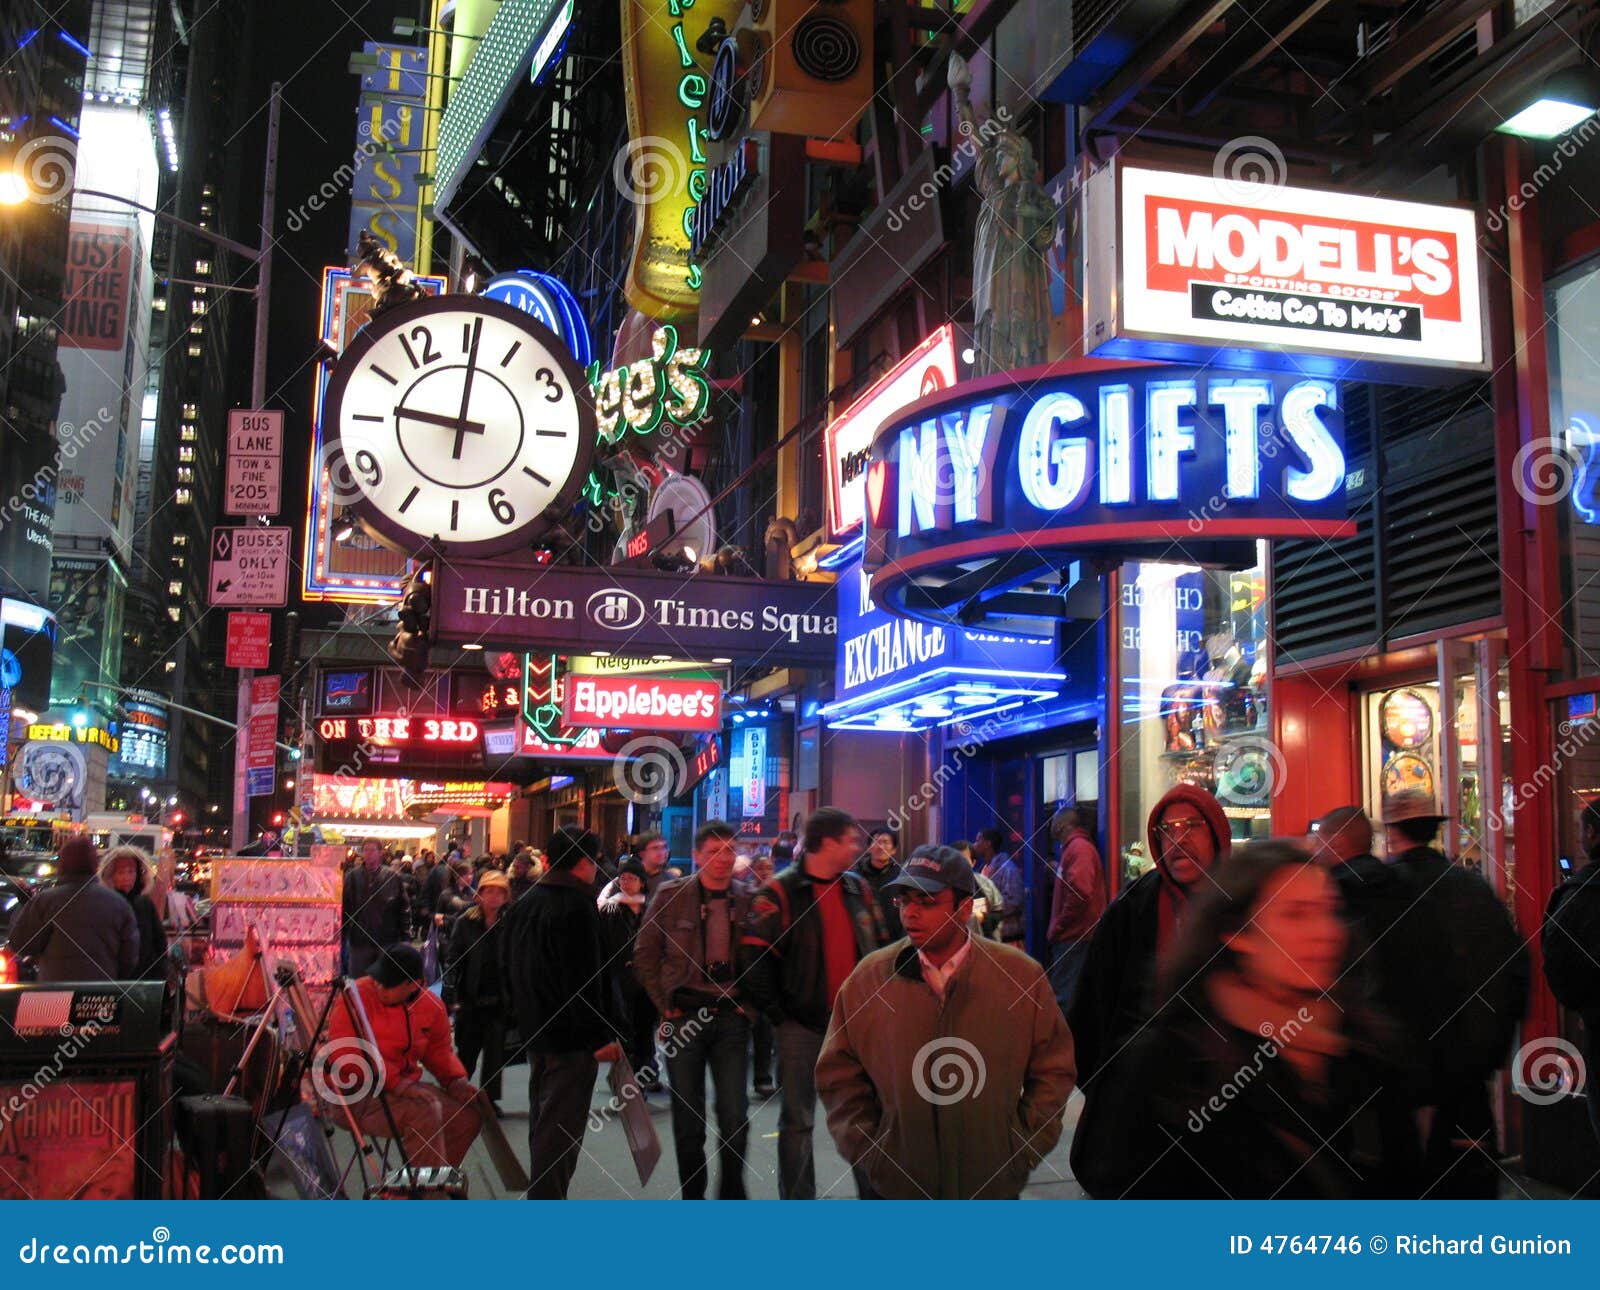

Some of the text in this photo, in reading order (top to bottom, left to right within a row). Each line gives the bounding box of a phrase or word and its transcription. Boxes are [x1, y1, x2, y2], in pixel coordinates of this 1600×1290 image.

[1157, 207, 1452, 295] MODELL'S
[1224, 273, 1322, 295] SPORTING
[1211, 290, 1281, 321] Gotta
[1282, 300, 1318, 326] Go
[1318, 302, 1347, 329] To
[398, 325, 442, 369] 12
[535, 367, 563, 403] 3
[242, 416, 270, 431] BUS
[236, 436, 273, 451] LANE
[897, 379, 1347, 538] NY GIFTS
[236, 459, 272, 469] TOW &
[241, 472, 266, 482] FINE
[355, 449, 382, 487] 9
[487, 487, 516, 526] 6
[236, 534, 283, 547] BUSES
[239, 556, 279, 569] ONLY
[461, 587, 575, 621] Hilton
[653, 598, 754, 631] Times
[595, 656, 673, 670] Neighb
[843, 617, 946, 690] EXCHANGE
[573, 681, 716, 720] Applebee's
[320, 719, 347, 739] ON
[357, 718, 411, 740] THE
[424, 720, 479, 741] 3RD
